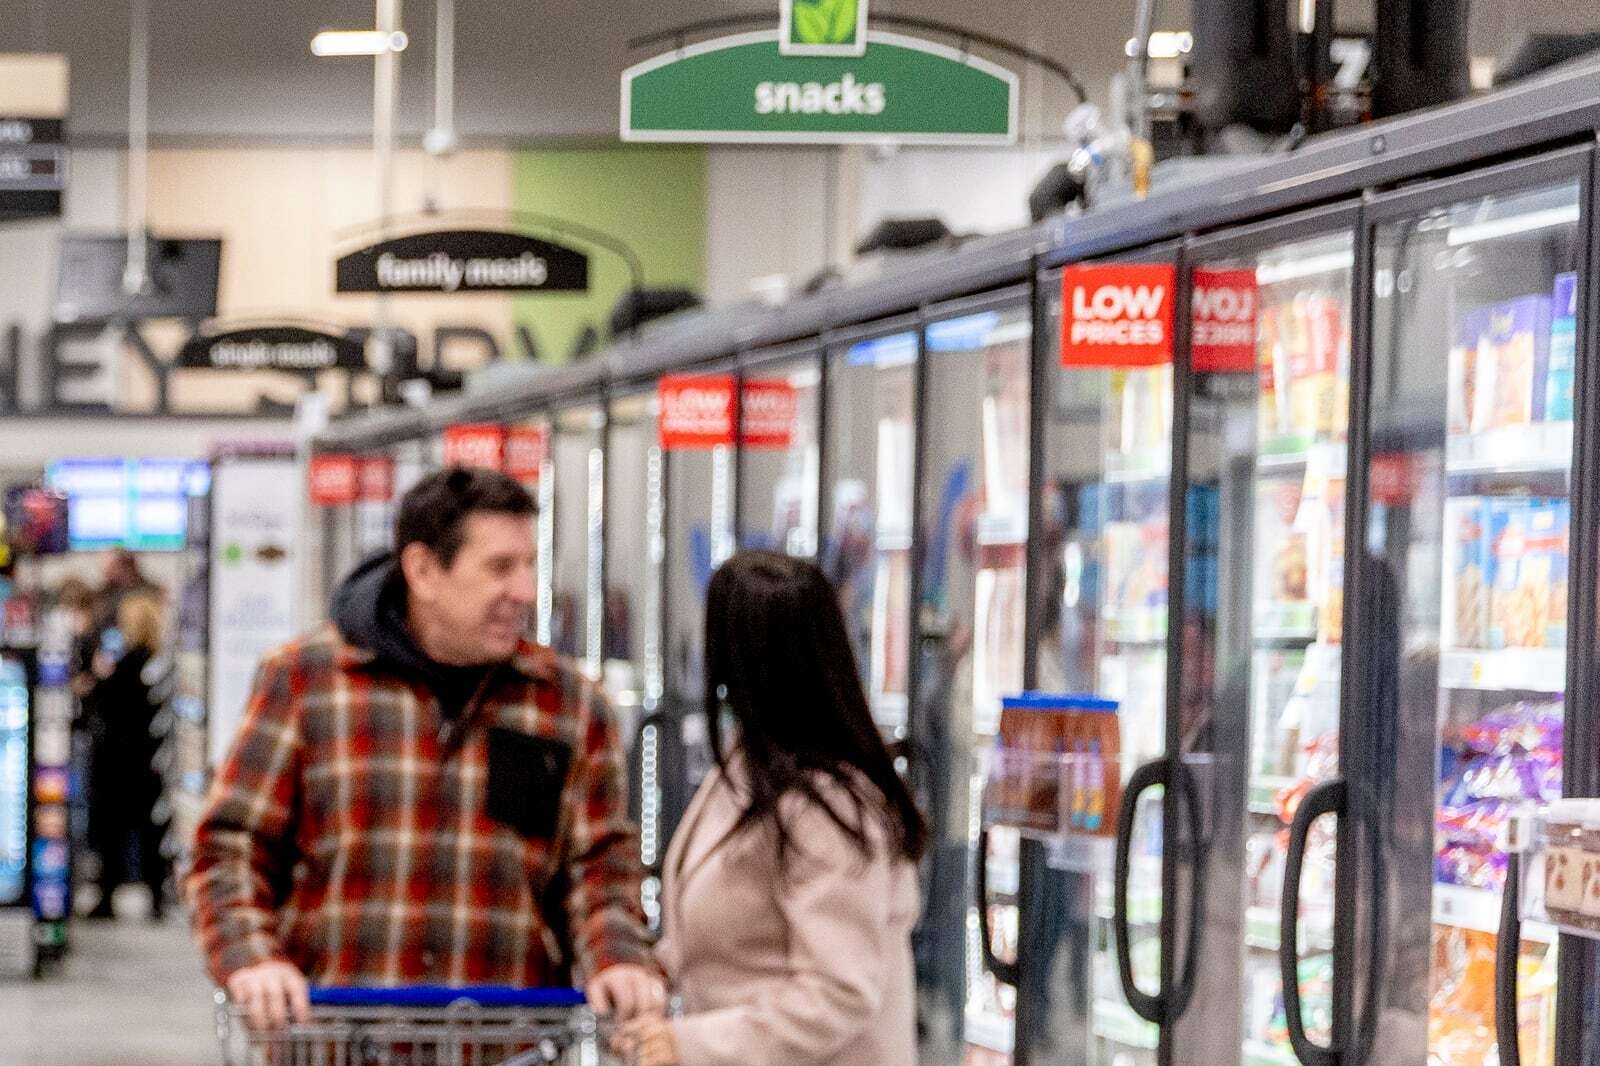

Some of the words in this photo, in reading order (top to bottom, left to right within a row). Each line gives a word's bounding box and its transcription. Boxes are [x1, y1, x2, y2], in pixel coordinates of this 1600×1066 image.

[1329, 37, 1372, 89] 7
[754, 74, 886, 115] snacks
[377, 252, 464, 291] family
[466, 251, 547, 287] meals
[1072, 285, 1165, 320] LOW
[1071, 319, 1164, 346] PRICES
